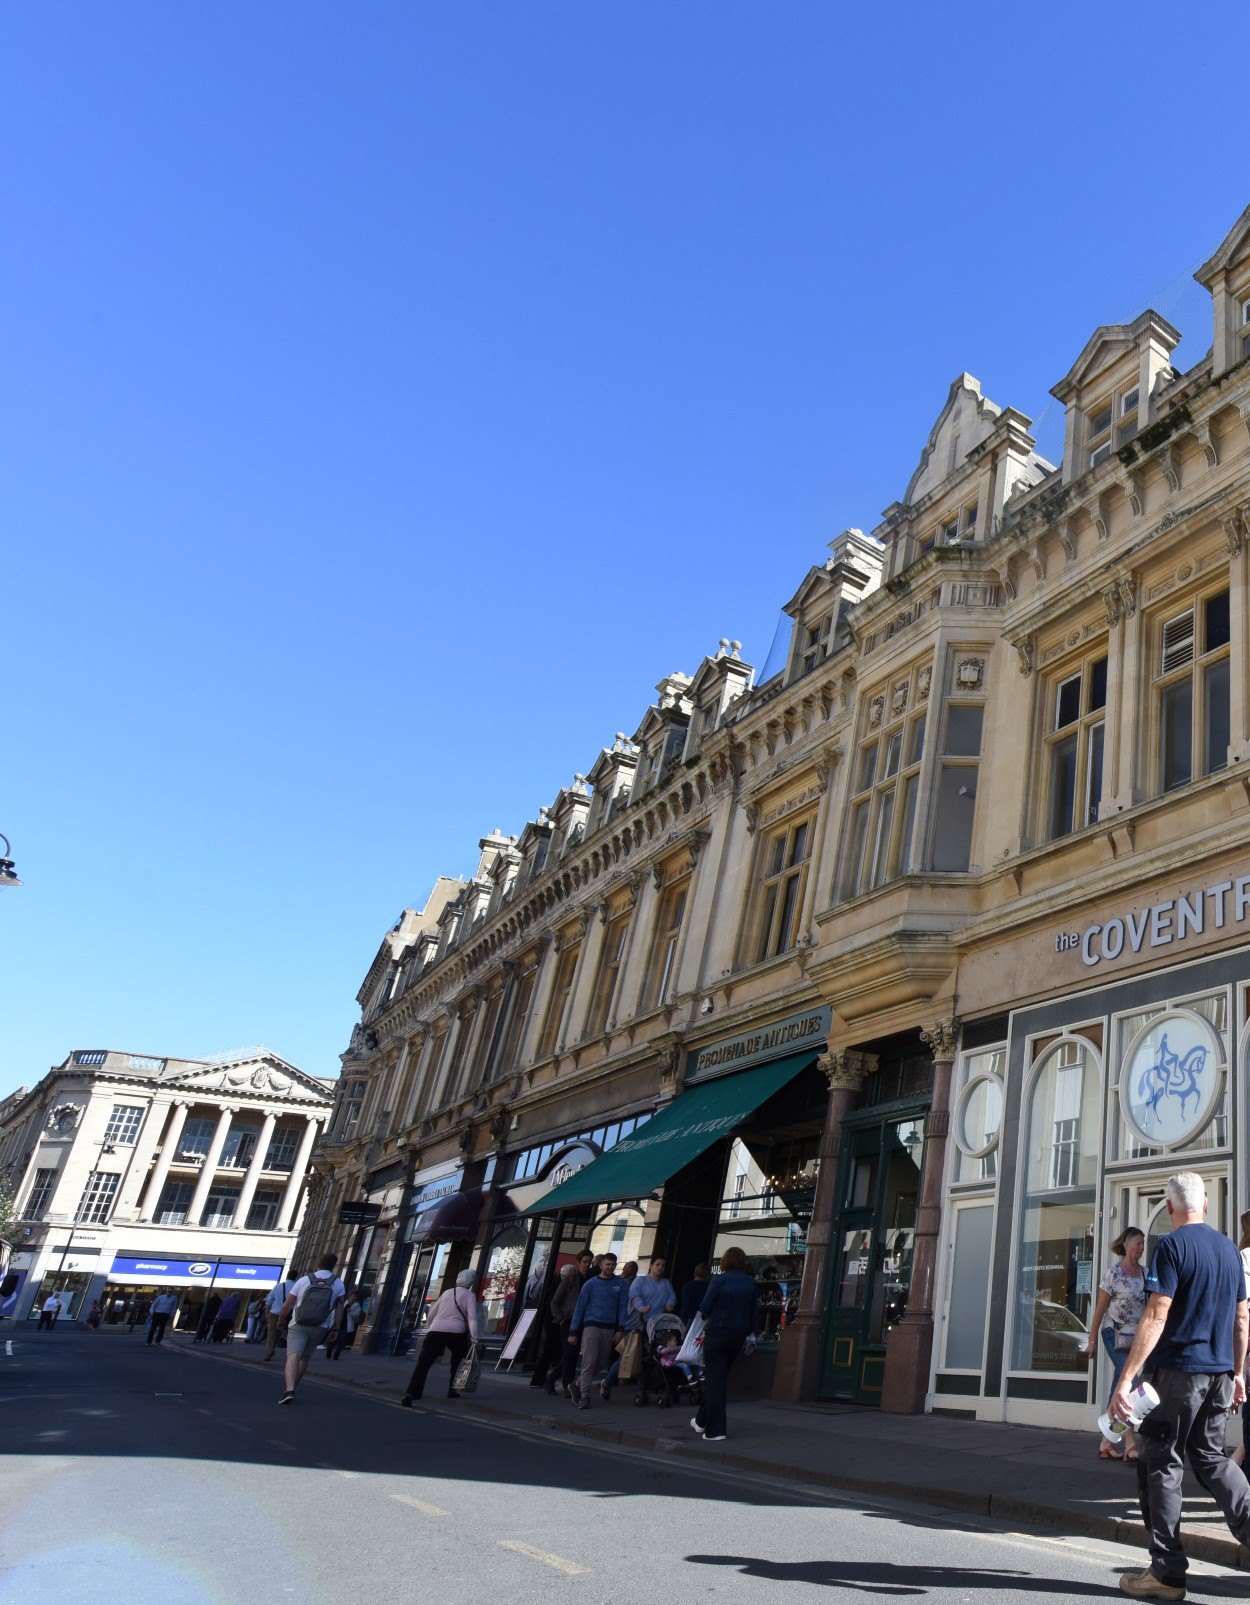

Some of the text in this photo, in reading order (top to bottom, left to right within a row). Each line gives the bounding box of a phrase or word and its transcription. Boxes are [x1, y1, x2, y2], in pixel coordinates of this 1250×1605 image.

[1050, 931, 1079, 952] the
[696, 1015, 823, 1071] PROMENADE ANTIQUES
[135, 1262, 257, 1275] pharmacy beauty
